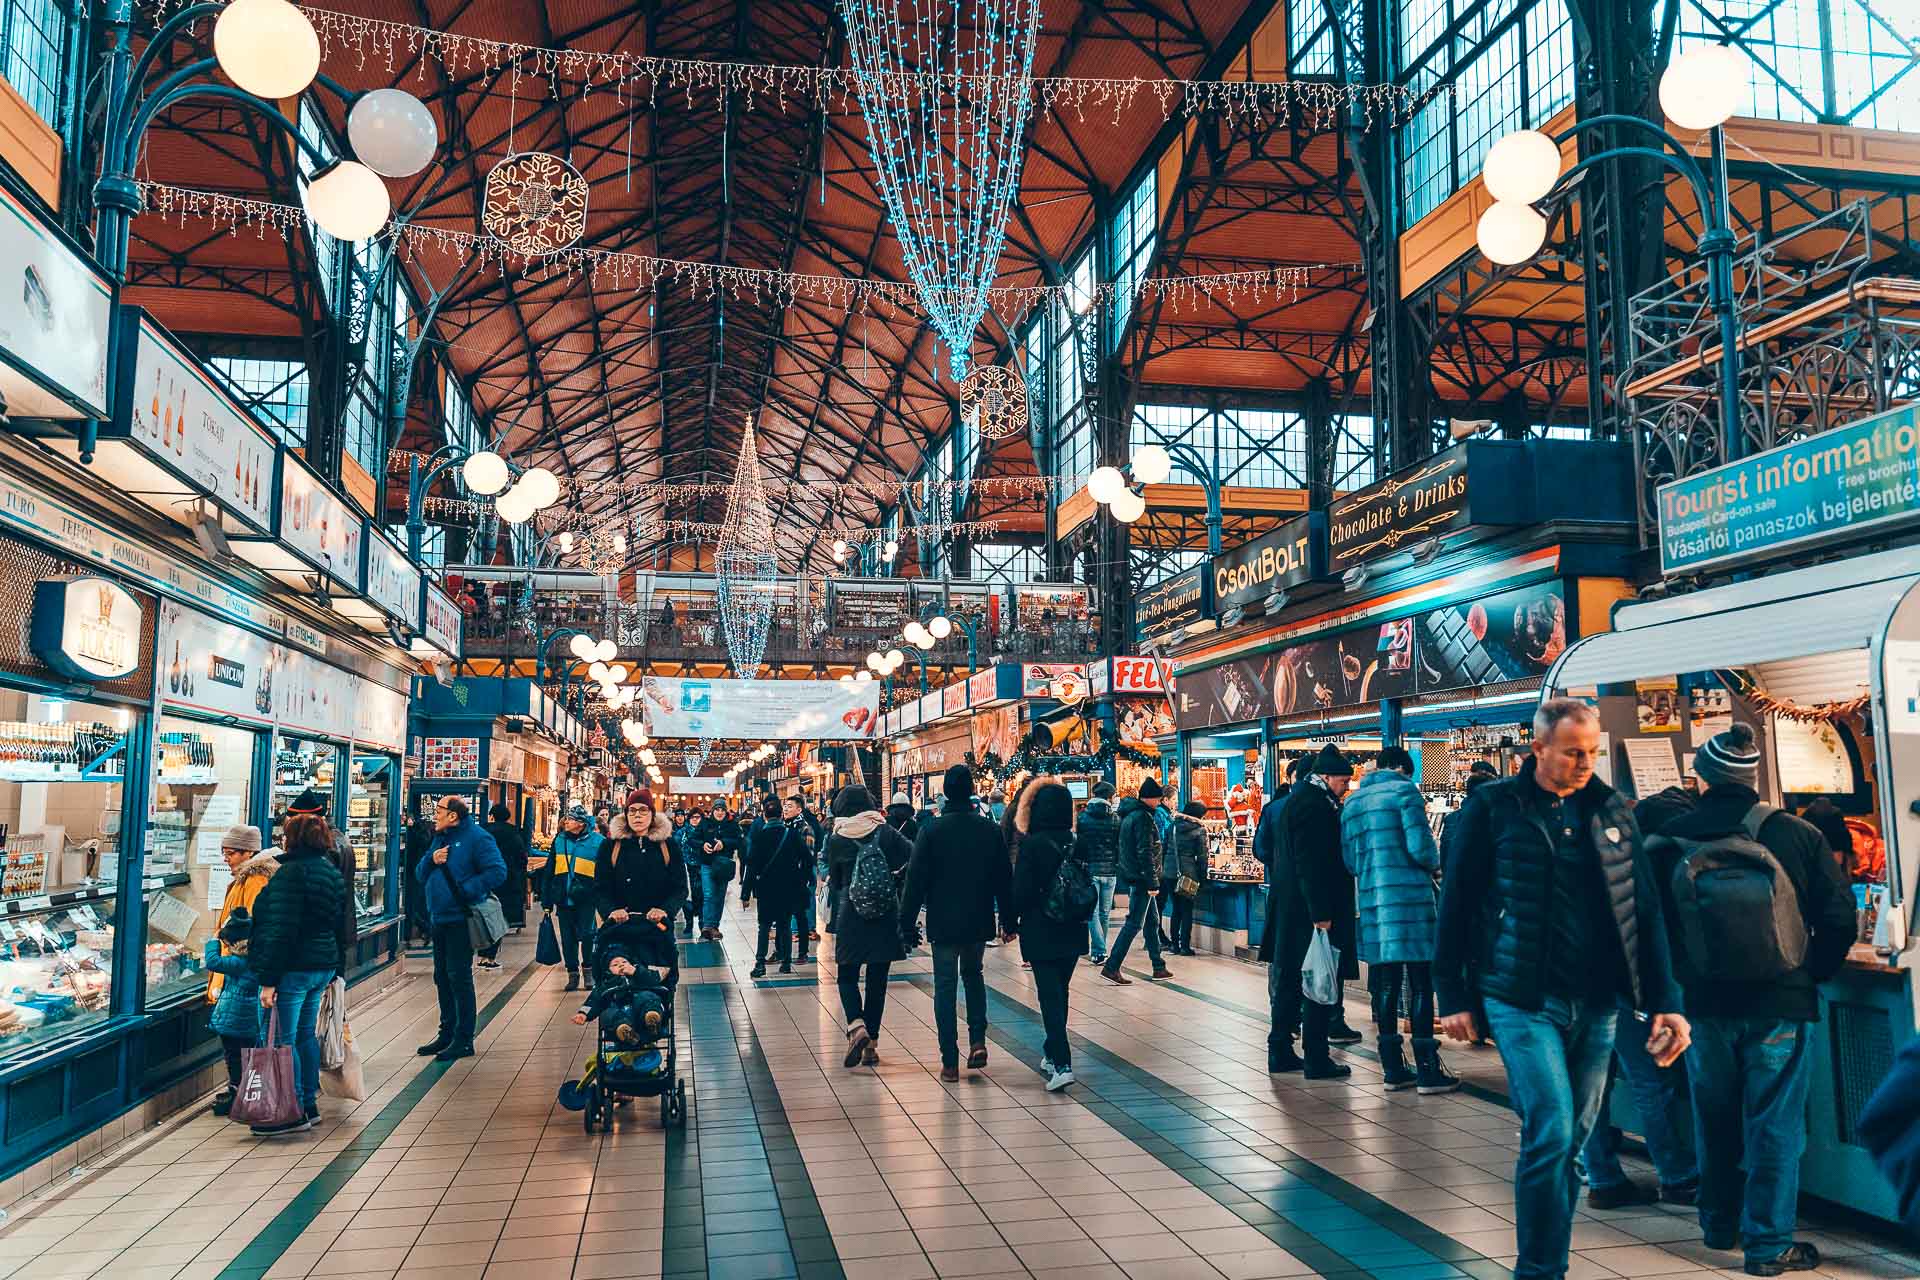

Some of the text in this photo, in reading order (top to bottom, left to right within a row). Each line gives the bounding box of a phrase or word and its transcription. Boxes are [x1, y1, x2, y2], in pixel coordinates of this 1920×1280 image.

[1663, 470, 1748, 521] Tourist
[1838, 473, 1866, 490] Free
[1330, 473, 1466, 545] Chocolate & Drinks
[1668, 527, 1730, 560] Vásárlói
[1734, 504, 1818, 549] panaszok
[215, 662, 244, 684] UNICUM
